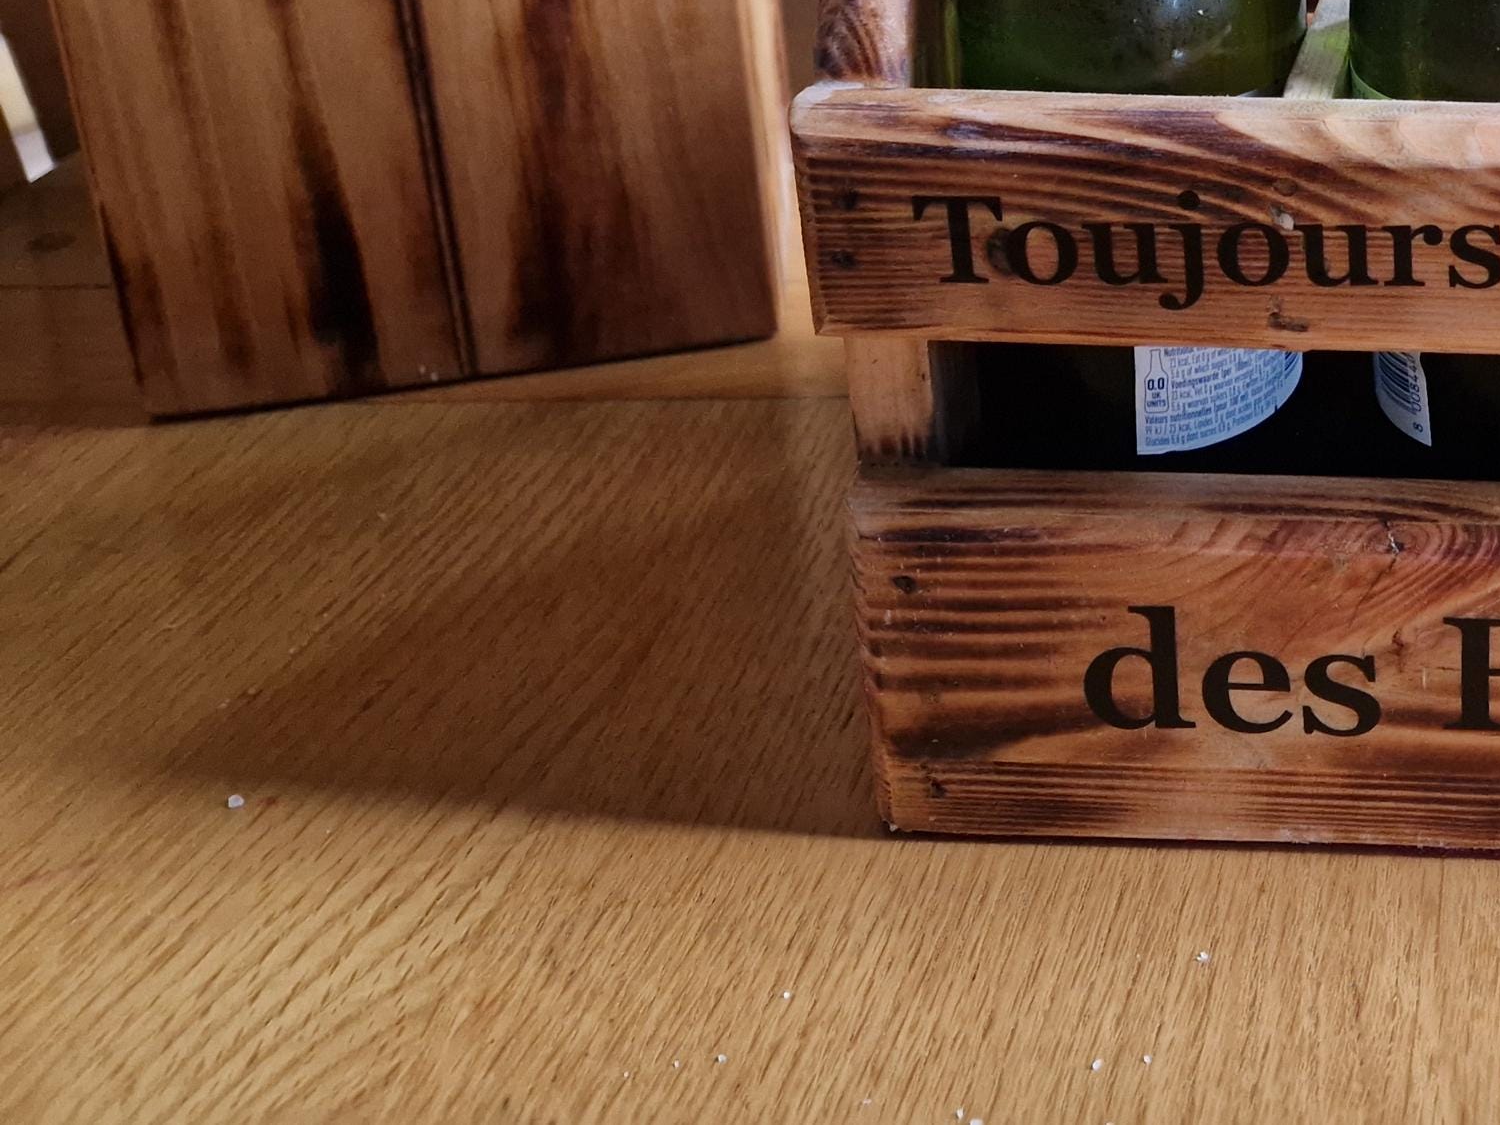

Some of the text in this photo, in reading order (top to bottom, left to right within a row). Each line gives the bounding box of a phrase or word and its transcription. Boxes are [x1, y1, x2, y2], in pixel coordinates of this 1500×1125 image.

[1147, 377, 1165, 391] 0.0
[1146, 399, 1167, 408] UNITS
[1083, 605, 1382, 738] des
